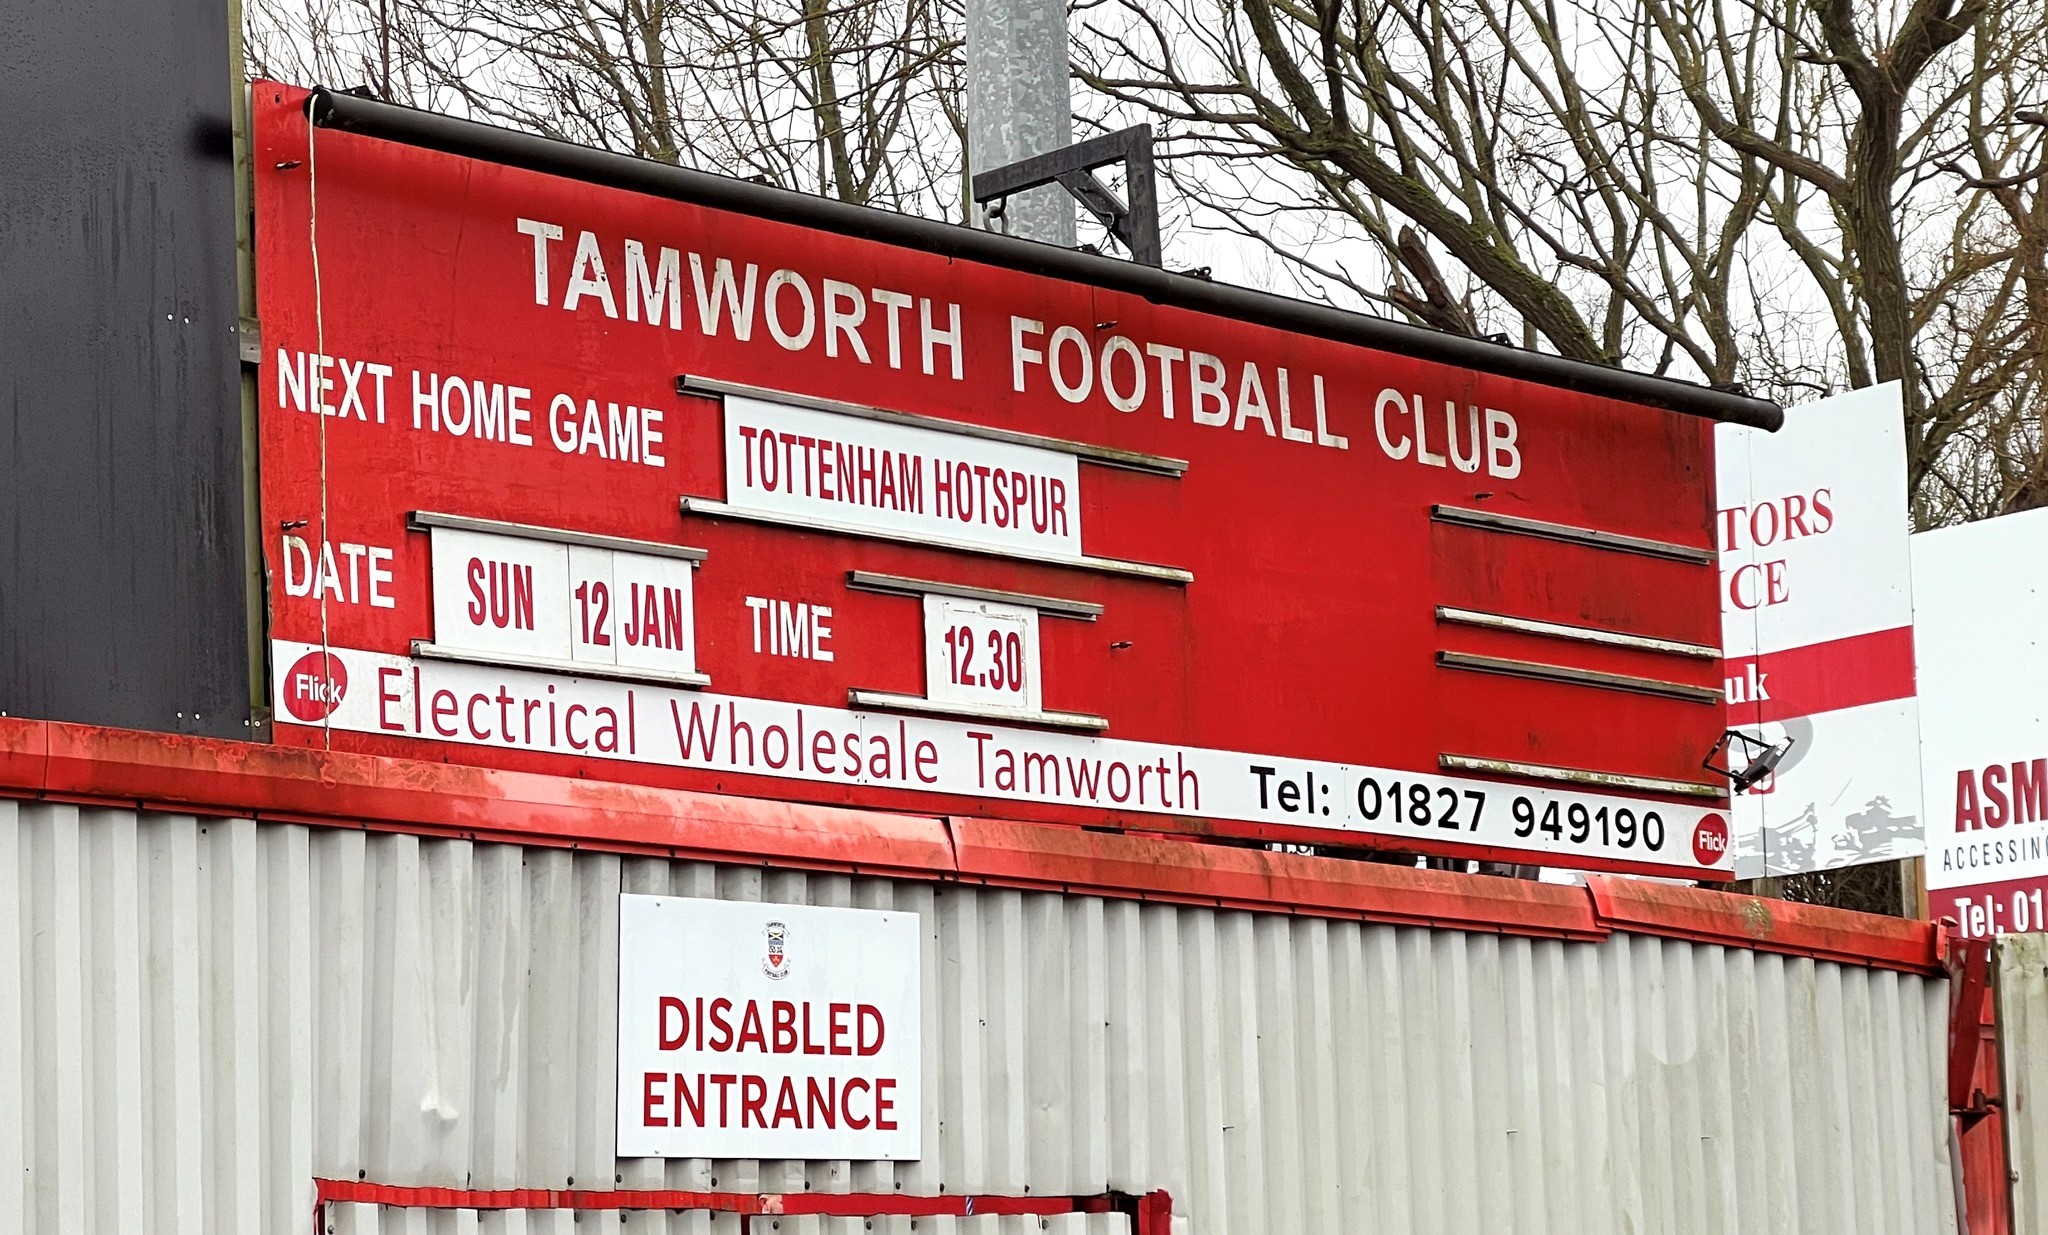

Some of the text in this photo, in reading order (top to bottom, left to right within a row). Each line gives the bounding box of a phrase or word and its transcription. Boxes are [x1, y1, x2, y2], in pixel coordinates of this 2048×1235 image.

[517, 217, 1522, 480] TAMWORTH FOOTBALL CLUB
[277, 348, 666, 468] NEXT HOME GAME
[739, 426, 1068, 537] TOTTENHAM HOTSPUR
[282, 535, 396, 610] DATE
[467, 557, 683, 651] SUN 12 JAN
[745, 596, 834, 662] TIME
[944, 625, 1023, 693] 12.30
[295, 672, 343, 706] Flick
[378, 665, 1666, 852] Electrical Wholesale Tamworth Tel: 01827 949190
[1955, 757, 2048, 833] ASM
[1698, 828, 1727, 853] Flick
[1943, 835, 2048, 872] ACCESSIN
[1954, 888, 2048, 939] Tel: 01
[659, 996, 886, 1057] DISABLED
[643, 1072, 898, 1131] ENTRANCE
